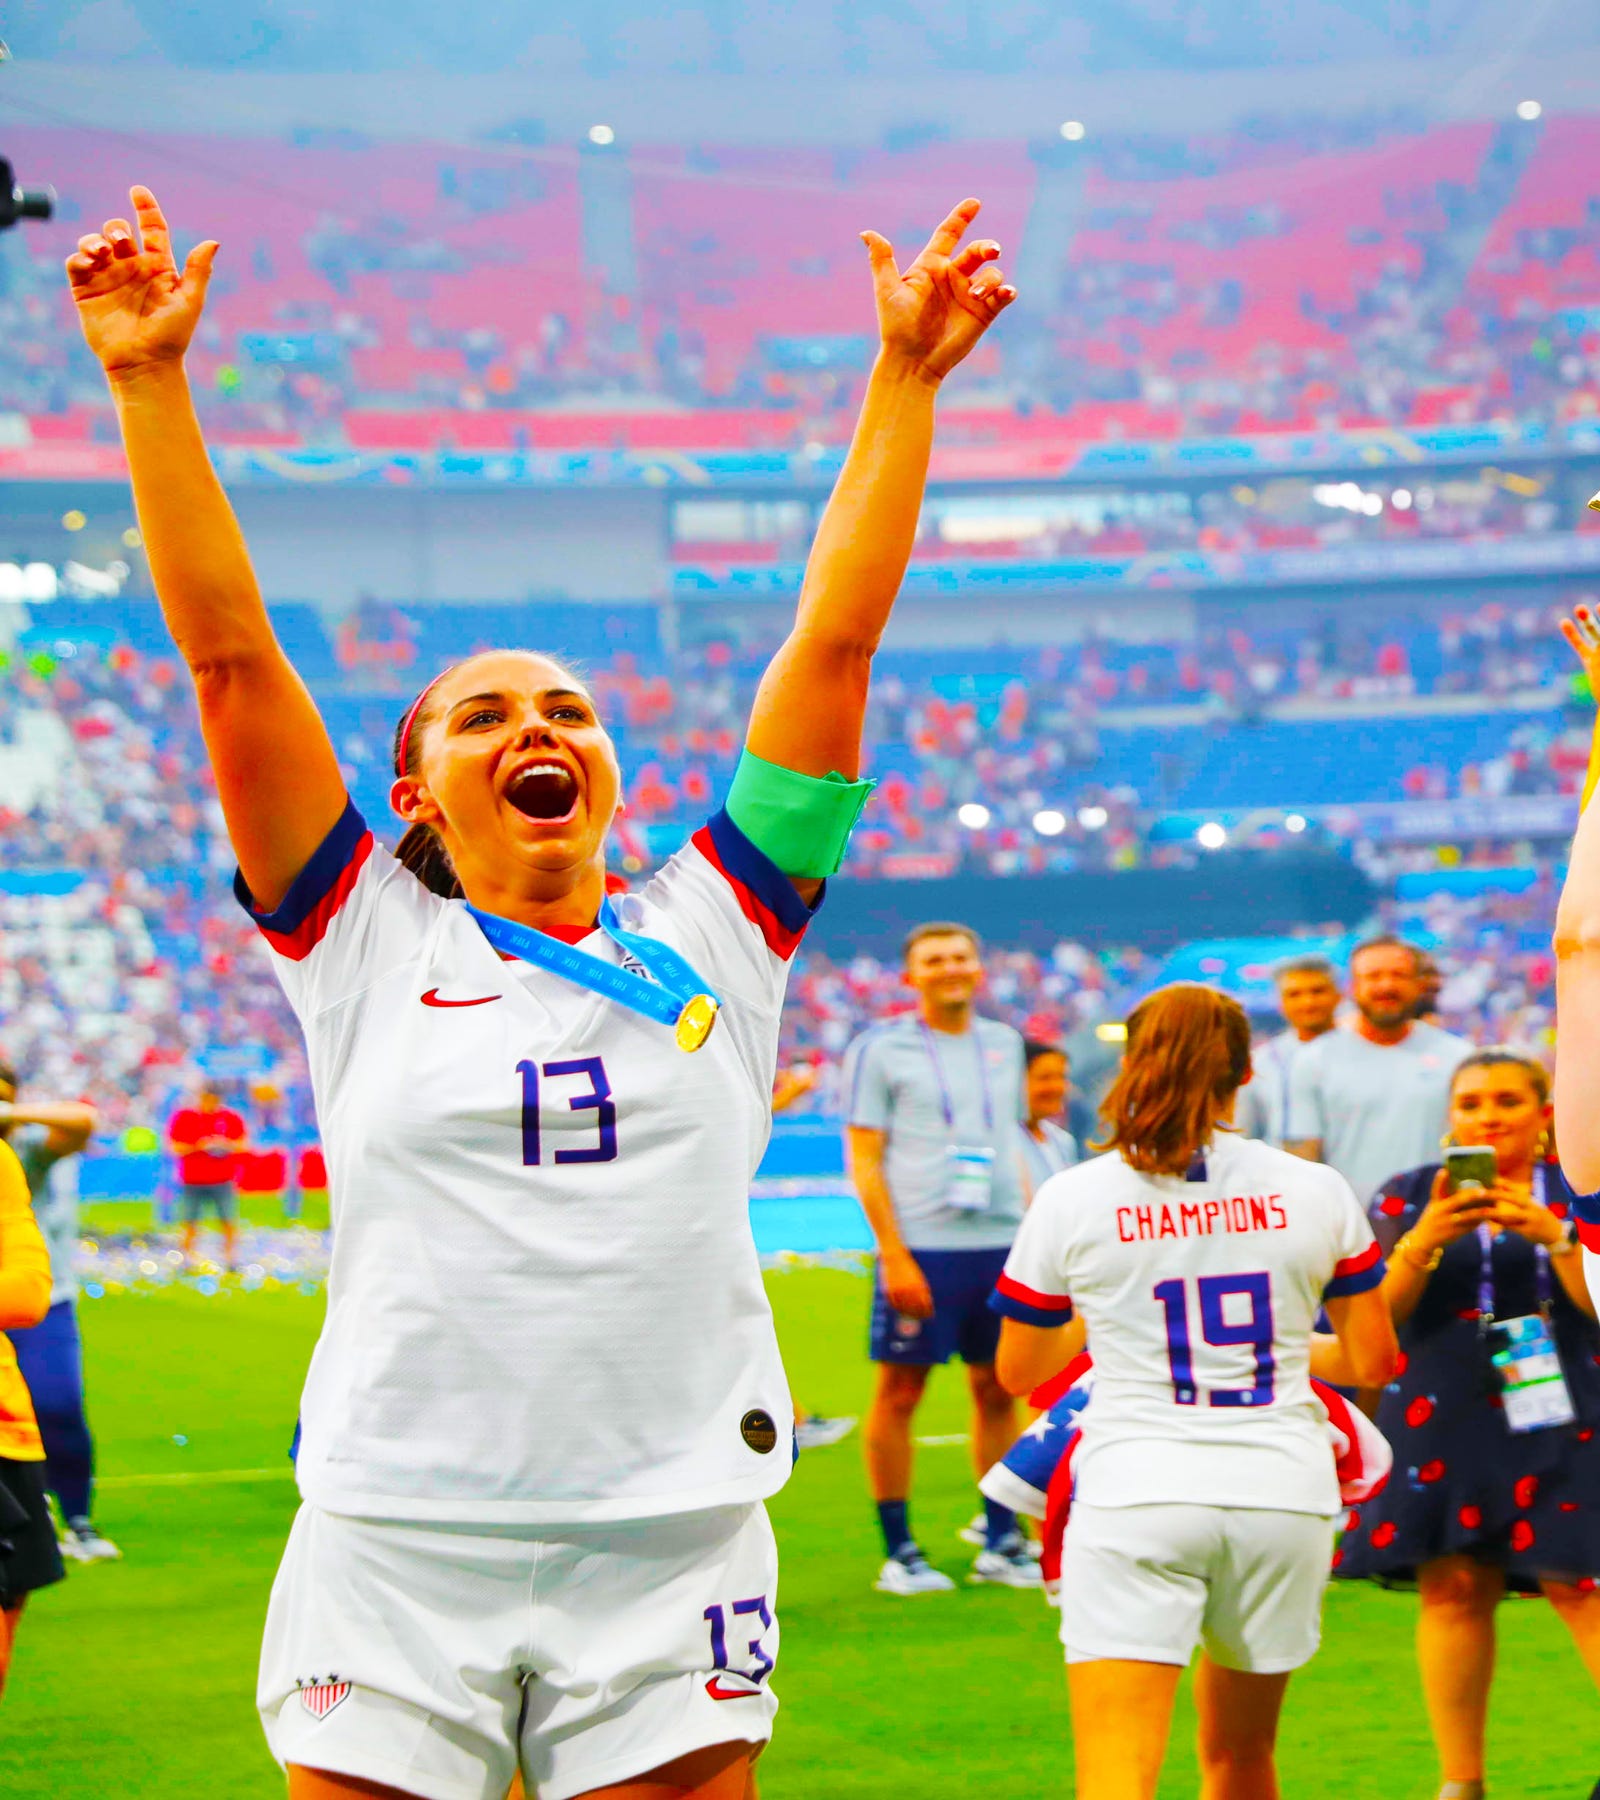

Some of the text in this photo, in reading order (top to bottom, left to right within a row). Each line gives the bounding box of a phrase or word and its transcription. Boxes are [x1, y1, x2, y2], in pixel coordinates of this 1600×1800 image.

[515, 1055, 618, 1167] 13
[1116, 1194, 1288, 1244] CHAMPIONS
[1153, 1271, 1276, 1408] 19
[703, 1593, 774, 1686] 13
